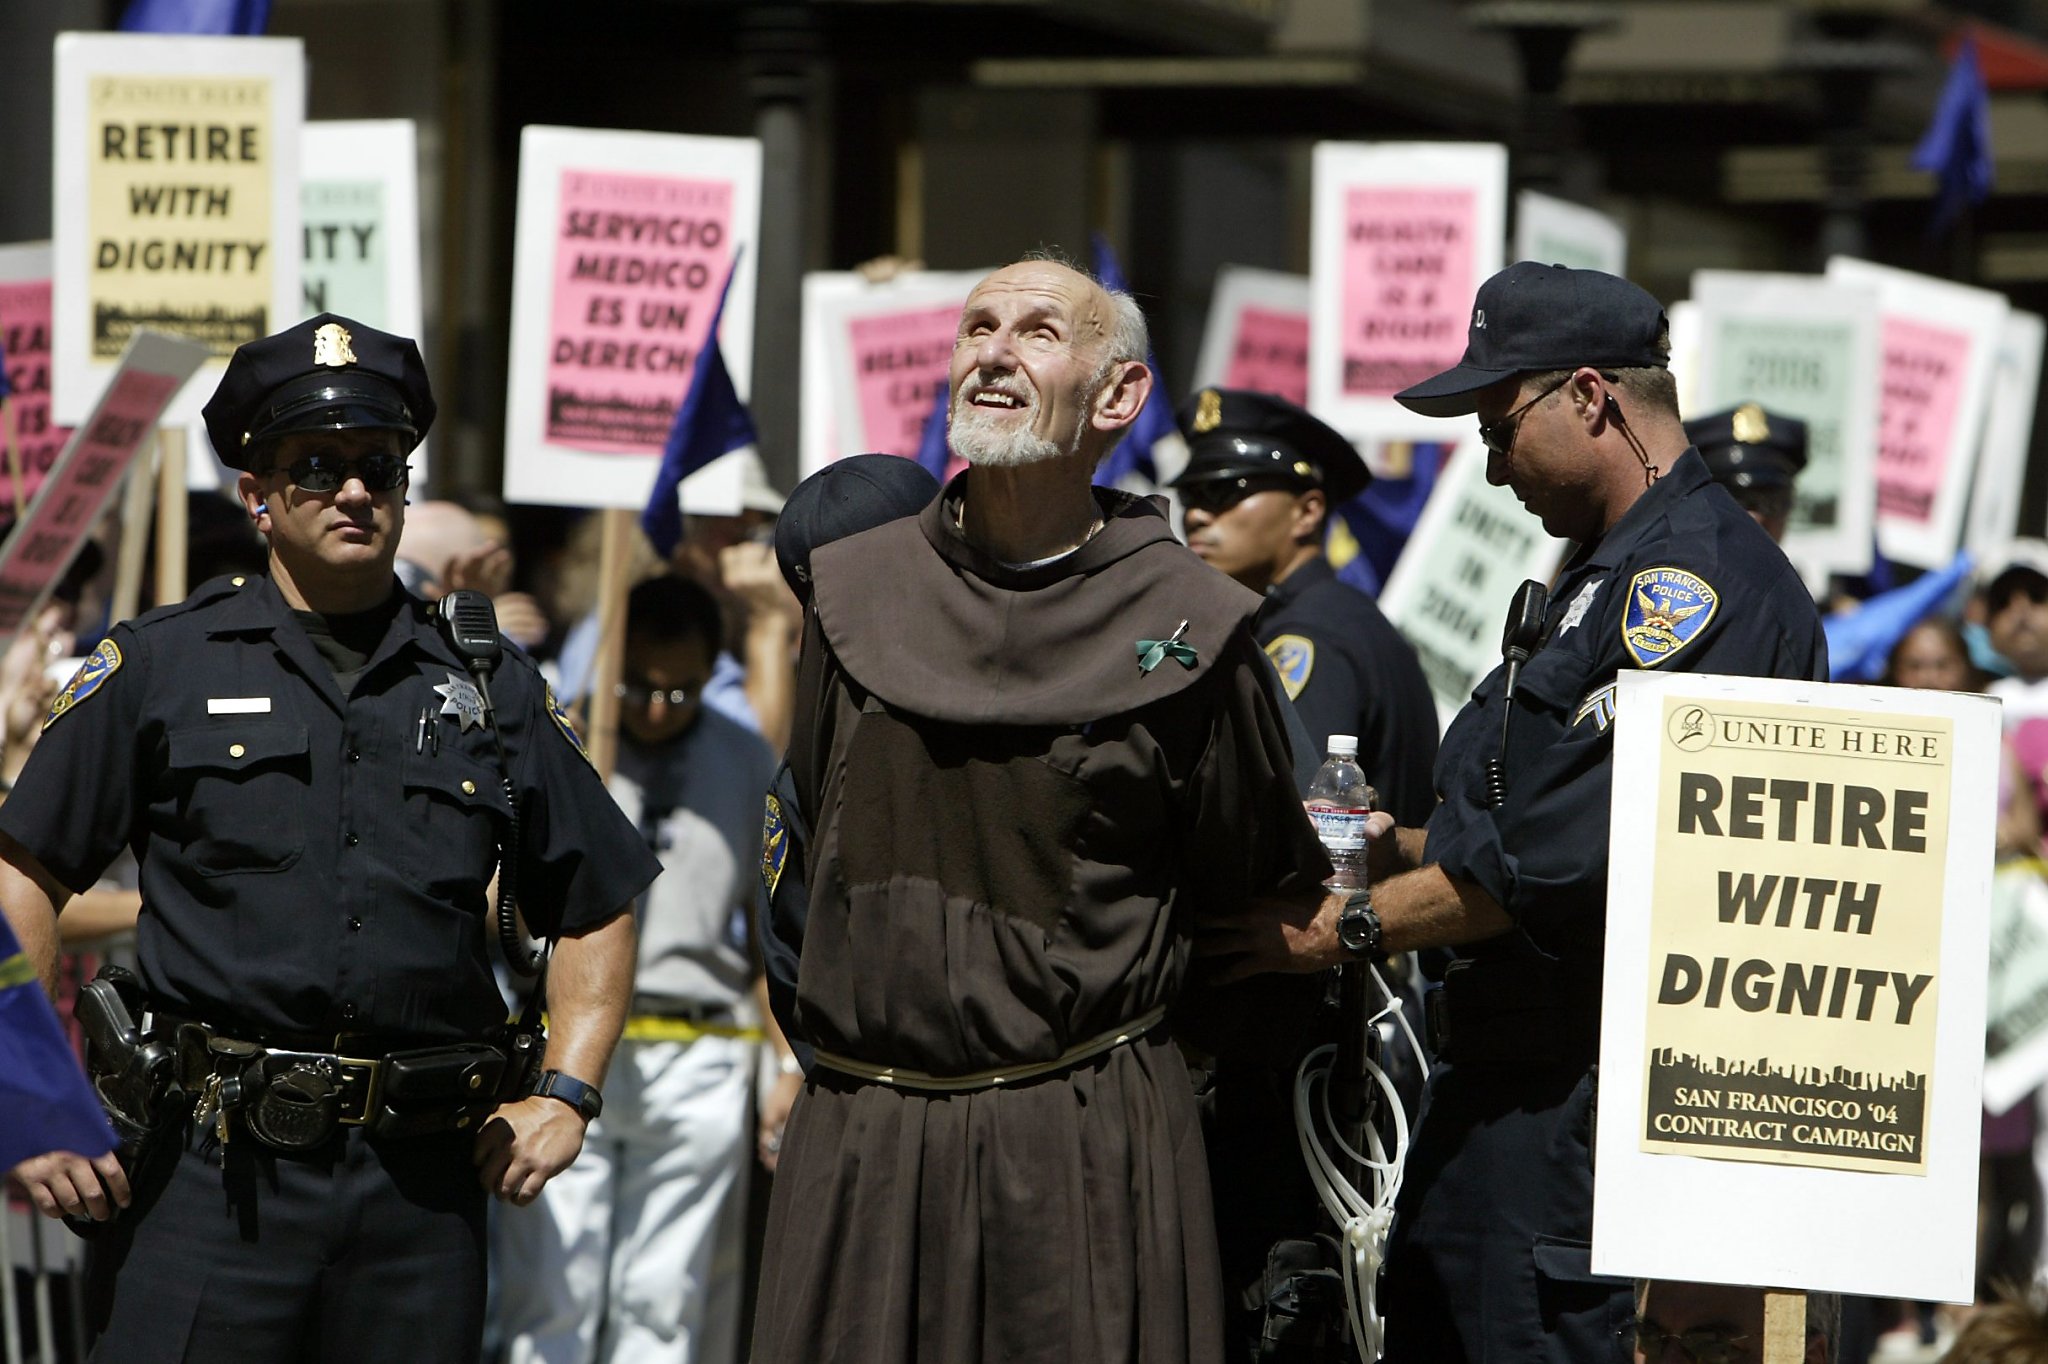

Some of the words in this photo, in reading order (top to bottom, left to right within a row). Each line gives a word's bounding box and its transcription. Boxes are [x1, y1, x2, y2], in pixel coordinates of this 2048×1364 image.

[103, 124, 258, 162] RETIRE
[130, 186, 231, 216] WITH
[565, 211, 722, 249] SERVICIO
[96, 241, 266, 272] DIGNITY
[572, 255, 710, 291] MEDICO
[586, 297, 623, 327] ES
[639, 302, 690, 331] UN
[554, 338, 694, 374] DERECH
[1636, 572, 1659, 589] SAN
[1661, 571, 1714, 604] FRANCISCO
[1651, 584, 1694, 603] POLICE
[1723, 720, 1827, 749] UNITE
[1841, 730, 1939, 759] HERE
[1678, 771, 1929, 854] RETIRE
[1718, 870, 1882, 935] WITH
[1657, 953, 1934, 1026] DIGNITY
[1674, 1086, 1722, 1109] SAN
[1726, 1090, 1862, 1122] FRANCISCO
[1654, 1113, 1787, 1142] CONTRACT
[1791, 1125, 1916, 1154] CAMPAIGN
